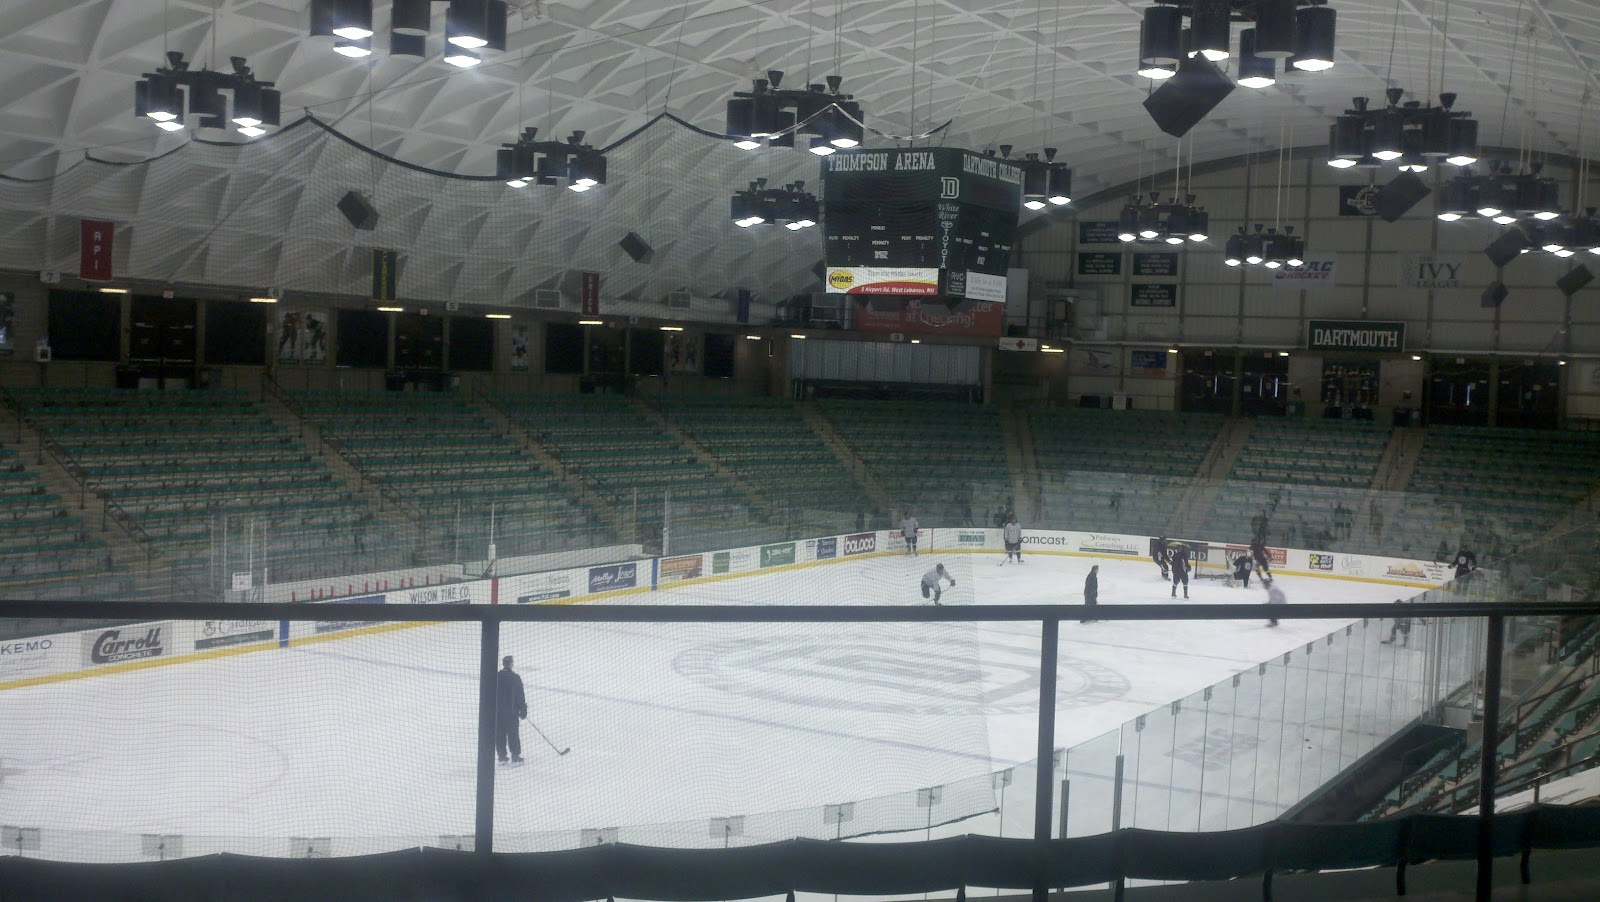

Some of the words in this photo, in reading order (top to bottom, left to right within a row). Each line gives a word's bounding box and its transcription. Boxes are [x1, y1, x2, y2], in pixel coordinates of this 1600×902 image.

[828, 153, 888, 172] THOMPSON
[895, 152, 935, 170] ARENA
[963, 153, 997, 179] DARTMOUTH
[999, 163, 1021, 185] COLLEGE
[941, 177, 960, 199] D
[937, 203, 960, 212] White
[939, 211, 959, 220] River
[940, 228, 950, 269] TOYOTA
[830, 275, 853, 283] MIDAS
[1286, 271, 1329, 279] HOCKEY
[1419, 263, 1462, 279] IVY
[1313, 328, 1399, 348] DARTMOUTH
[1019, 535, 1066, 545] omcast
[410, 590, 438, 604] WILSON
[441, 587, 456, 600] TIRE
[1, 639, 53, 655] KEMO
[91, 627, 161, 664] Carroll
[108, 650, 153, 662] CONCRETE
